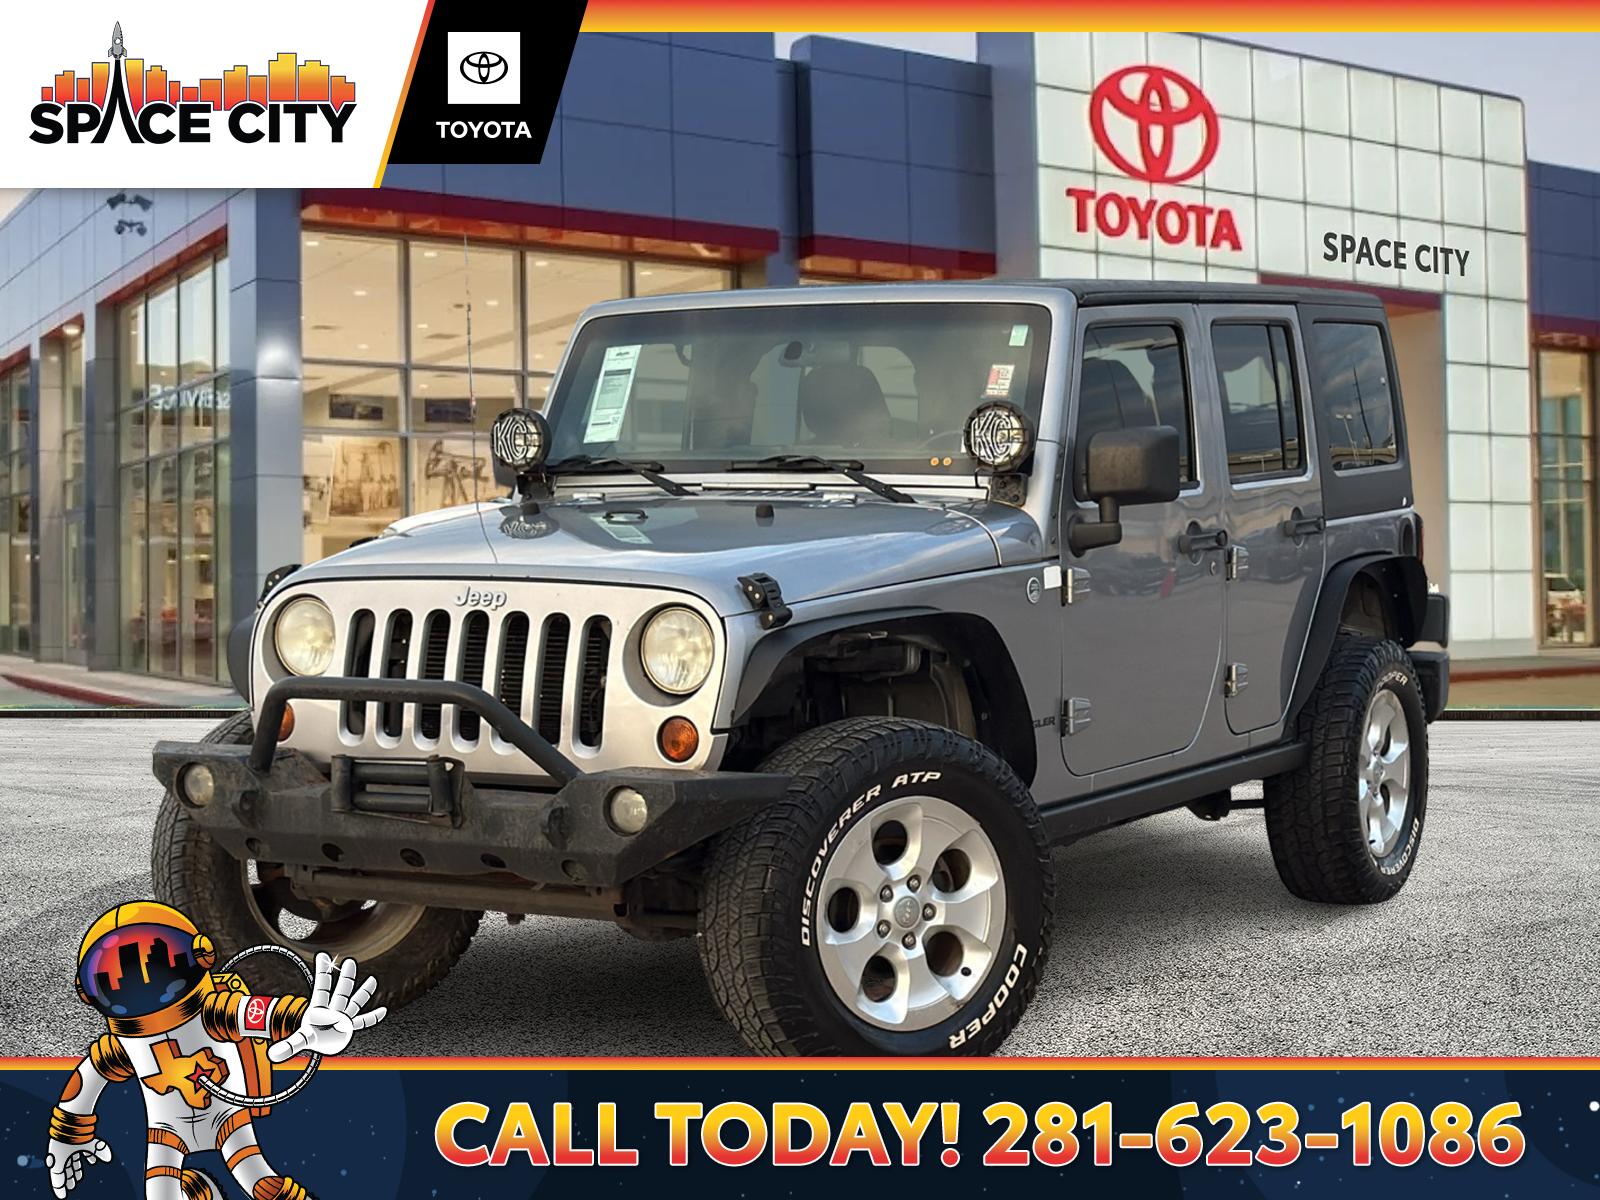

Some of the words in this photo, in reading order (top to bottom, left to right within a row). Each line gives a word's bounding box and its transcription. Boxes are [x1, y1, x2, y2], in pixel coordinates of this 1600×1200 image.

[1066, 187, 1242, 251] TOYOTA
[1323, 232, 1407, 270] SPACE
[1414, 243, 1470, 276] CITY
[455, 584, 507, 611] Jeep
[801, 784, 882, 947] DISCOVERER
[891, 771, 942, 789] ATP
[949, 943, 1028, 1050] COOPER
